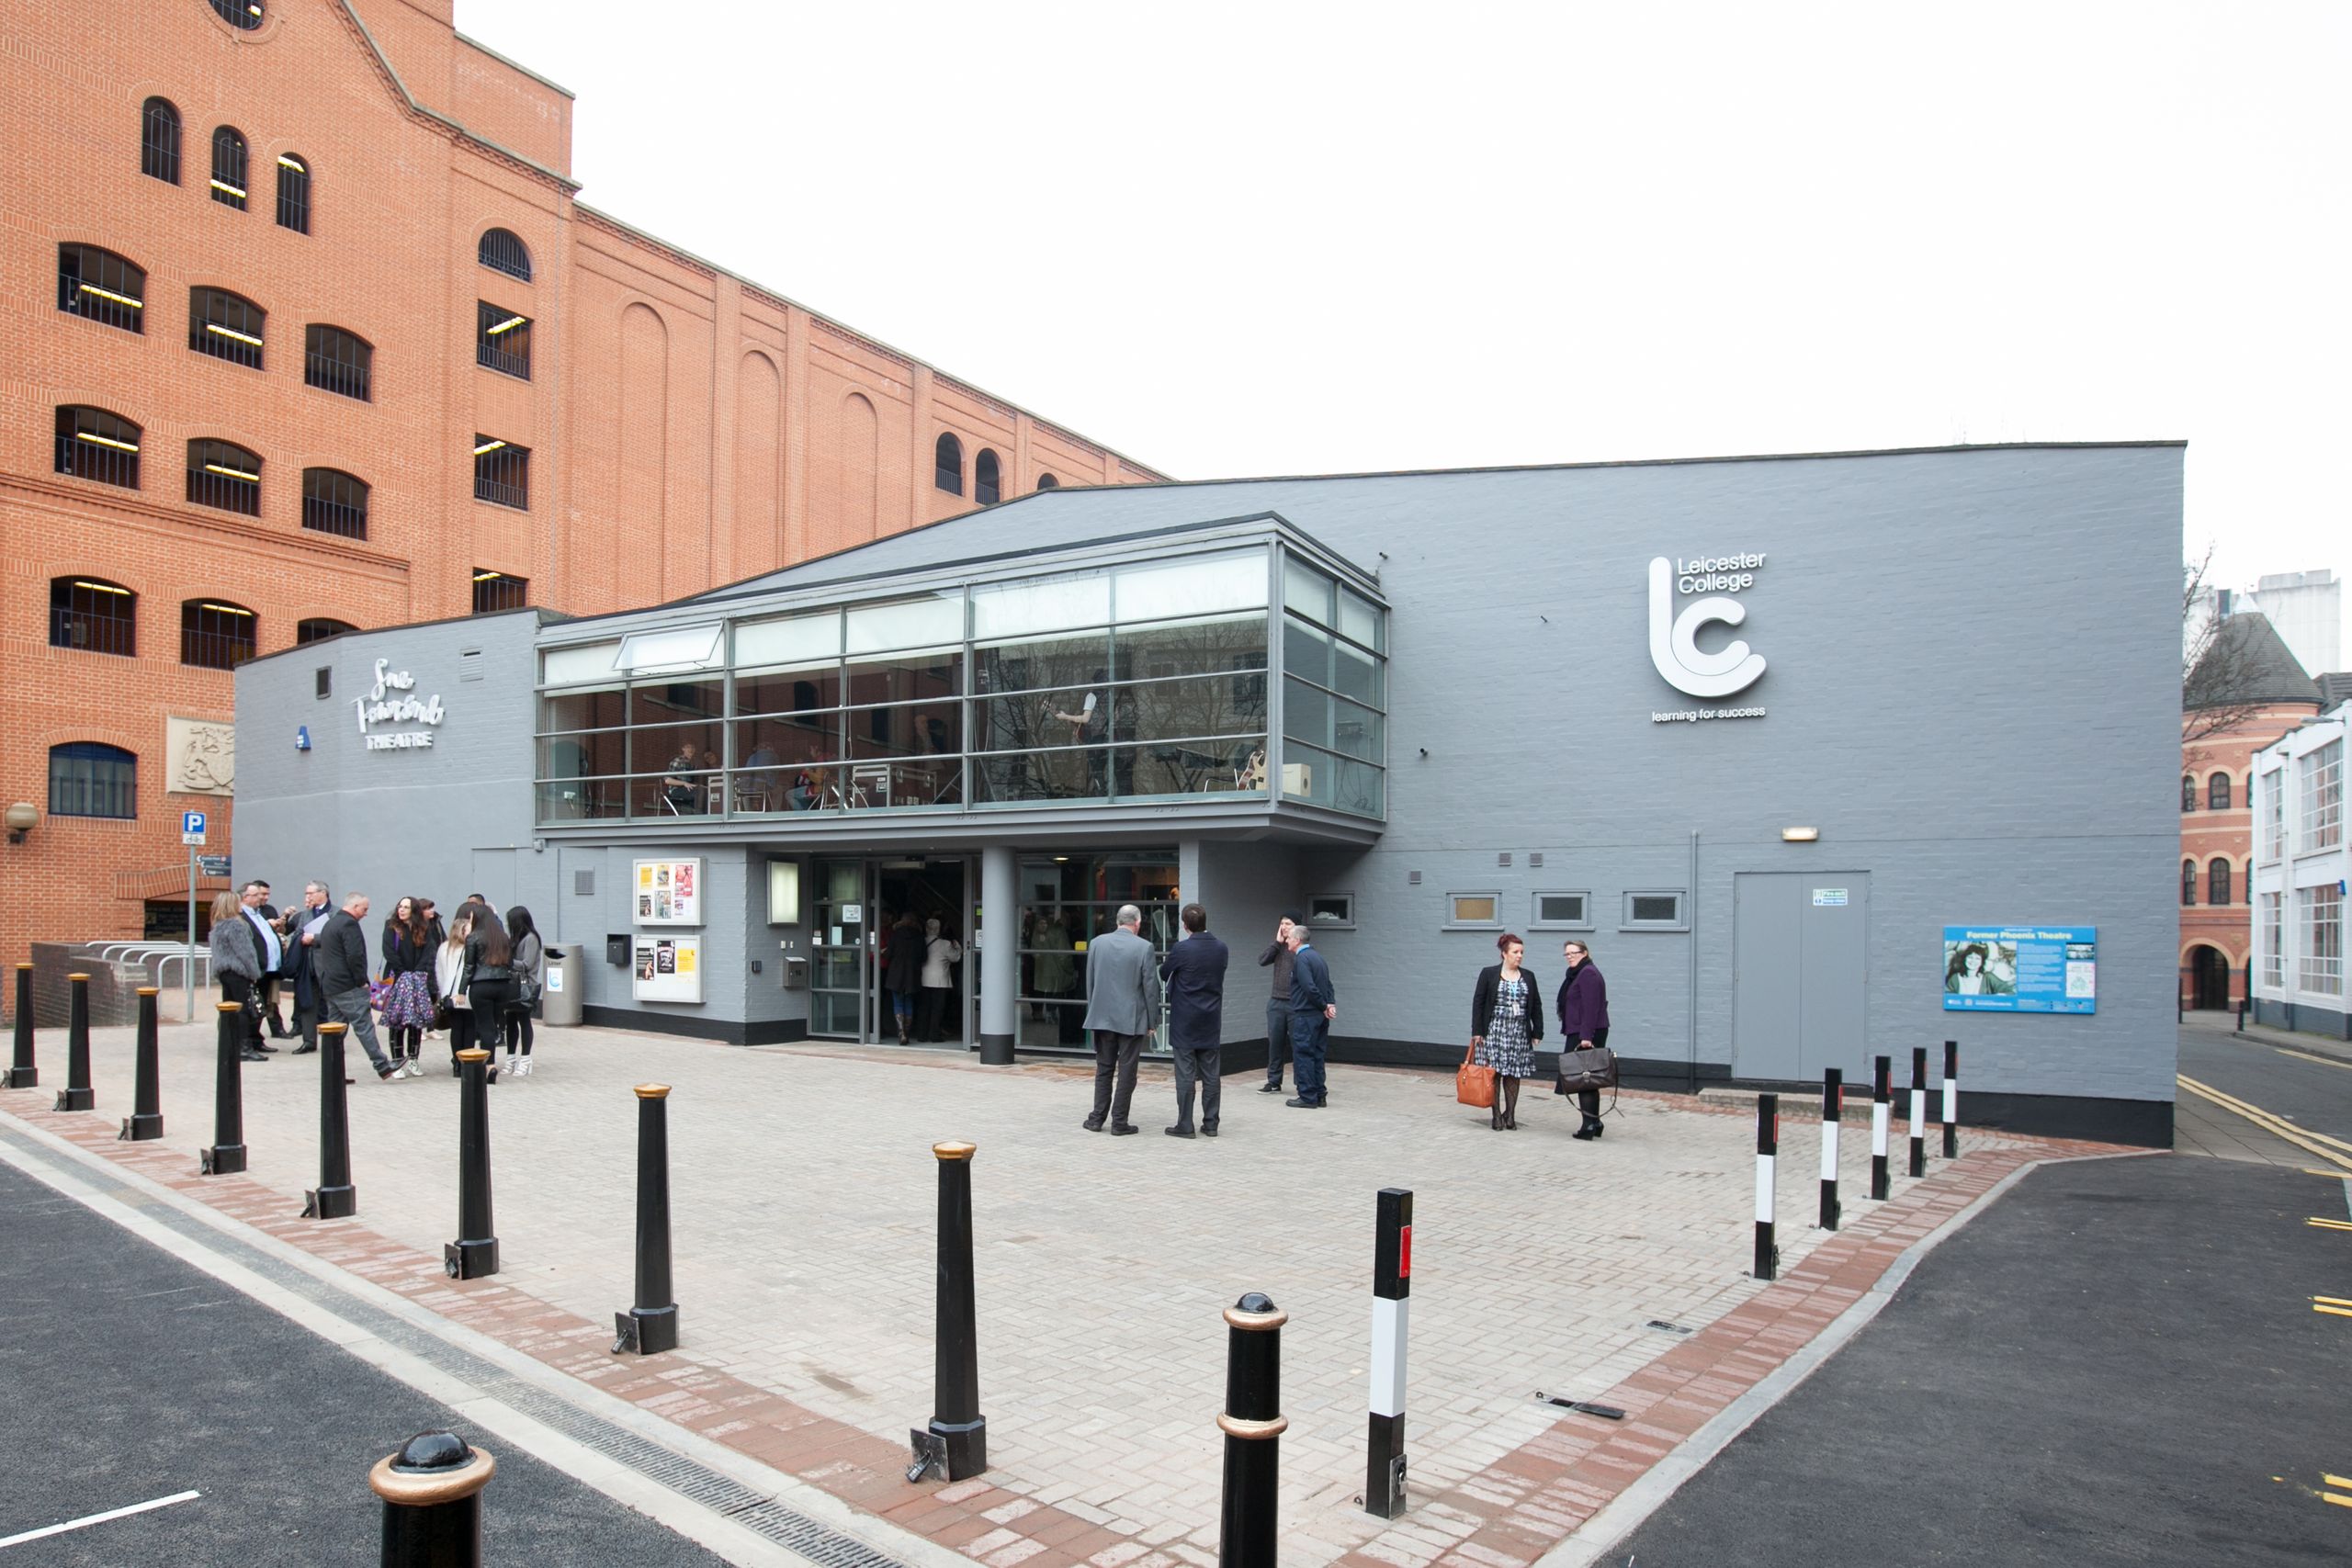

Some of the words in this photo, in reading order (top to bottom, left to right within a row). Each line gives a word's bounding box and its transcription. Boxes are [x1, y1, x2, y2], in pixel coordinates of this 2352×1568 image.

[1678, 552, 1766, 575] Leicester
[1679, 572, 1754, 594] College
[370, 658, 415, 702] Sue
[1651, 710, 1697, 723] learning
[1699, 708, 1716, 720] for
[1718, 706, 1767, 719] success
[365, 731, 433, 750] THEATRE
[187, 814, 202, 831] P
[2000, 931, 2036, 940] Phoenix
[2039, 931, 2073, 940] Theatre
